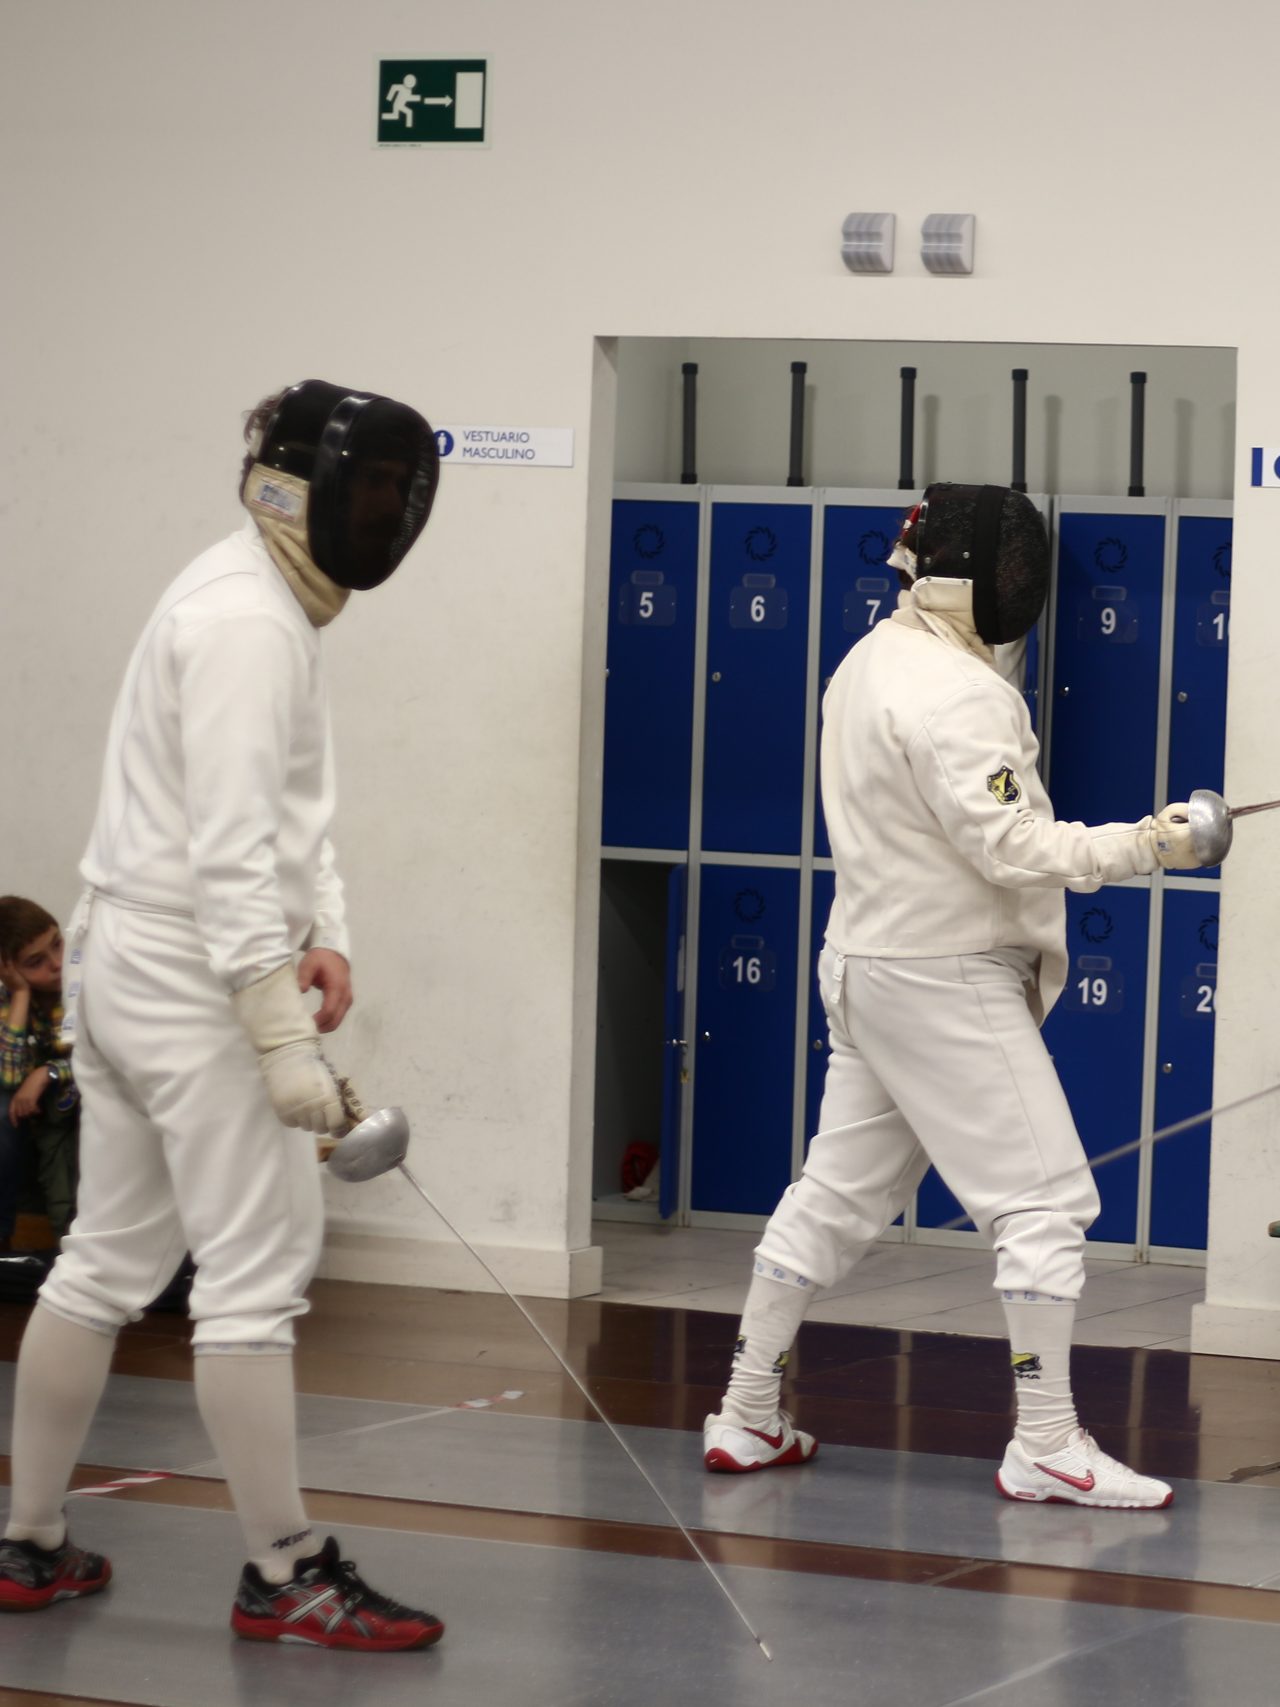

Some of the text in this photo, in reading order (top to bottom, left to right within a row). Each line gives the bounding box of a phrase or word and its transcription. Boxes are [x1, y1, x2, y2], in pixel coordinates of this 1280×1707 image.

[463, 430, 530, 443] VESTUARIO
[462, 447, 535, 460] MASCULINO
[638, 591, 653, 618] 5
[750, 595, 765, 622] 6
[866, 599, 881, 626] 7
[1101, 607, 1116, 635] 9
[1212, 612, 1231, 641] 1
[732, 956, 761, 984] 16
[1077, 977, 1107, 1005] 19
[1195, 985, 1217, 1013] 2
